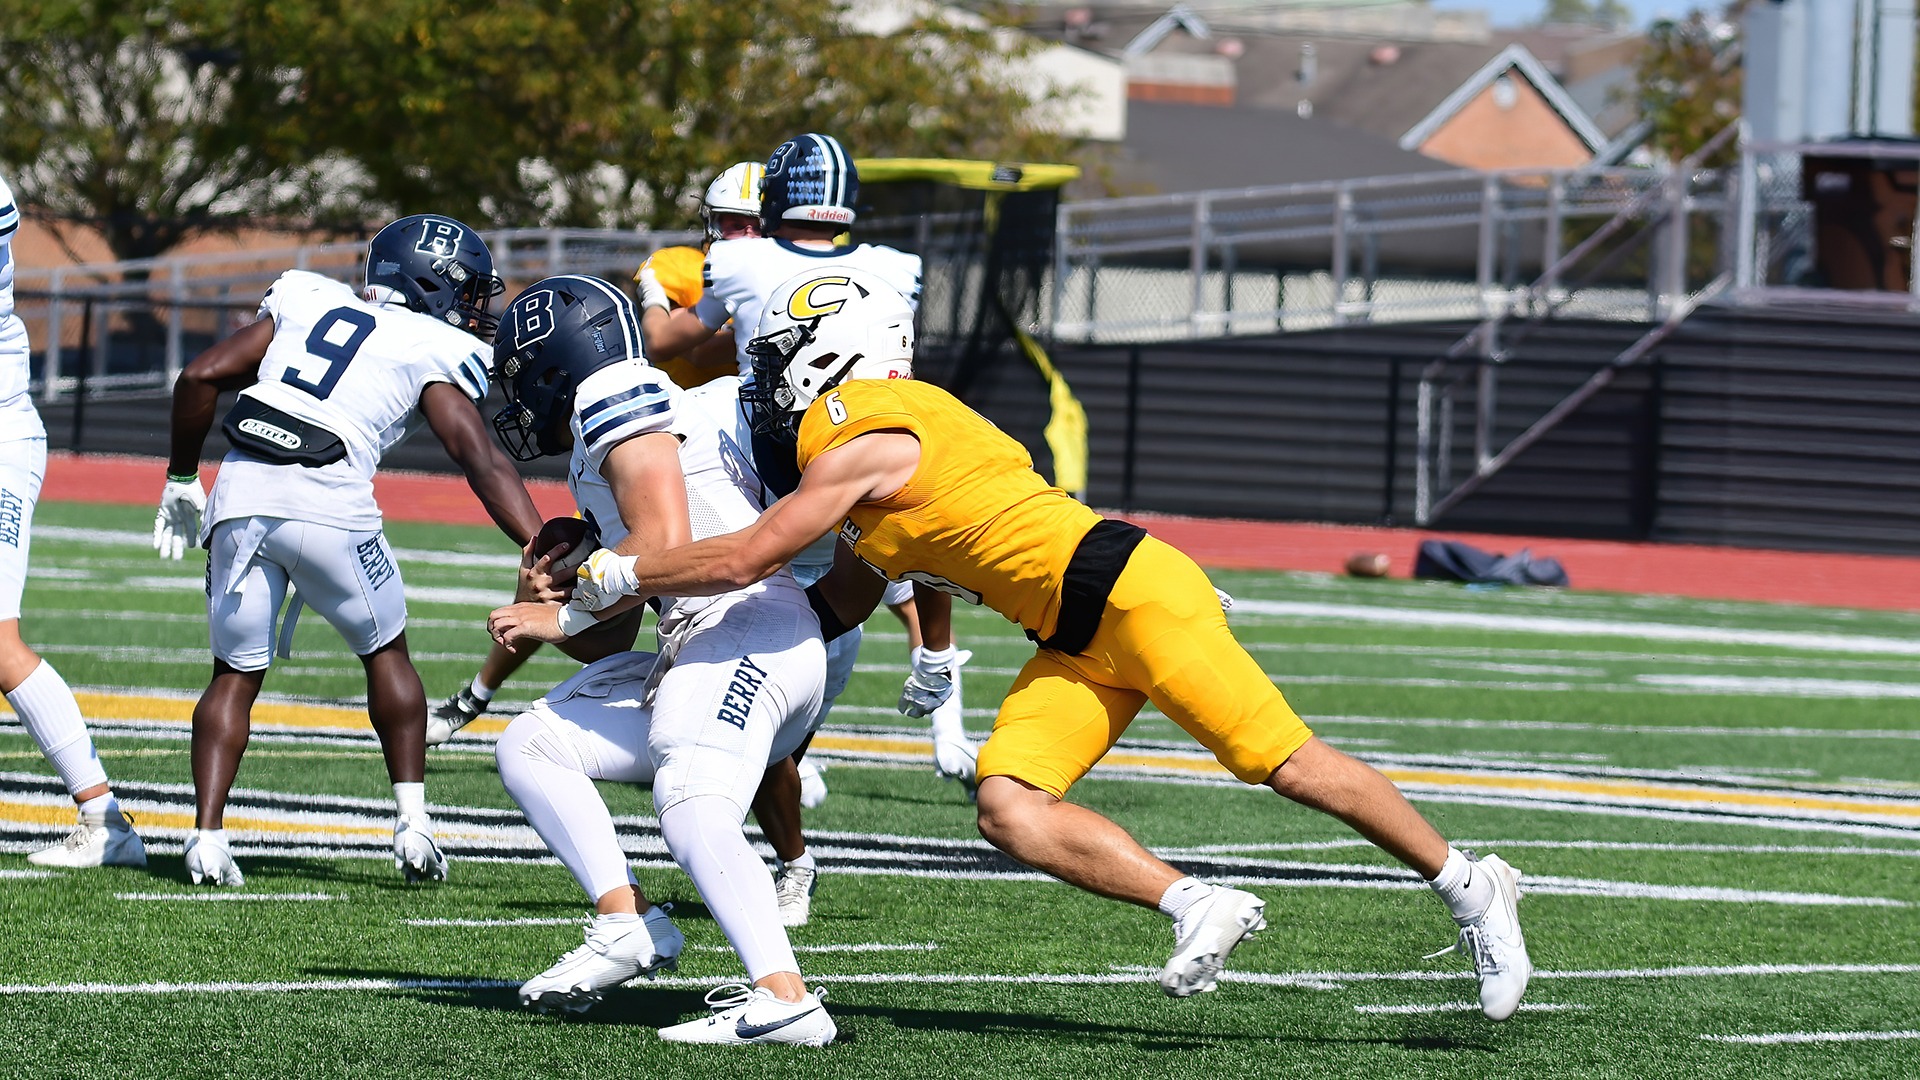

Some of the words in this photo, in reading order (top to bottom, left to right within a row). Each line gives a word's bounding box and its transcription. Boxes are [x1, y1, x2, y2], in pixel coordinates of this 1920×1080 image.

[807, 208, 849, 222] Riddell
[414, 218, 464, 259] B
[512, 289, 556, 351] B
[787, 275, 851, 321] C
[280, 305, 377, 402] 9
[901, 335, 908, 348] 6
[824, 390, 849, 426] 6
[356, 536, 395, 591] BERRY
[716, 655, 768, 731] BERRY
